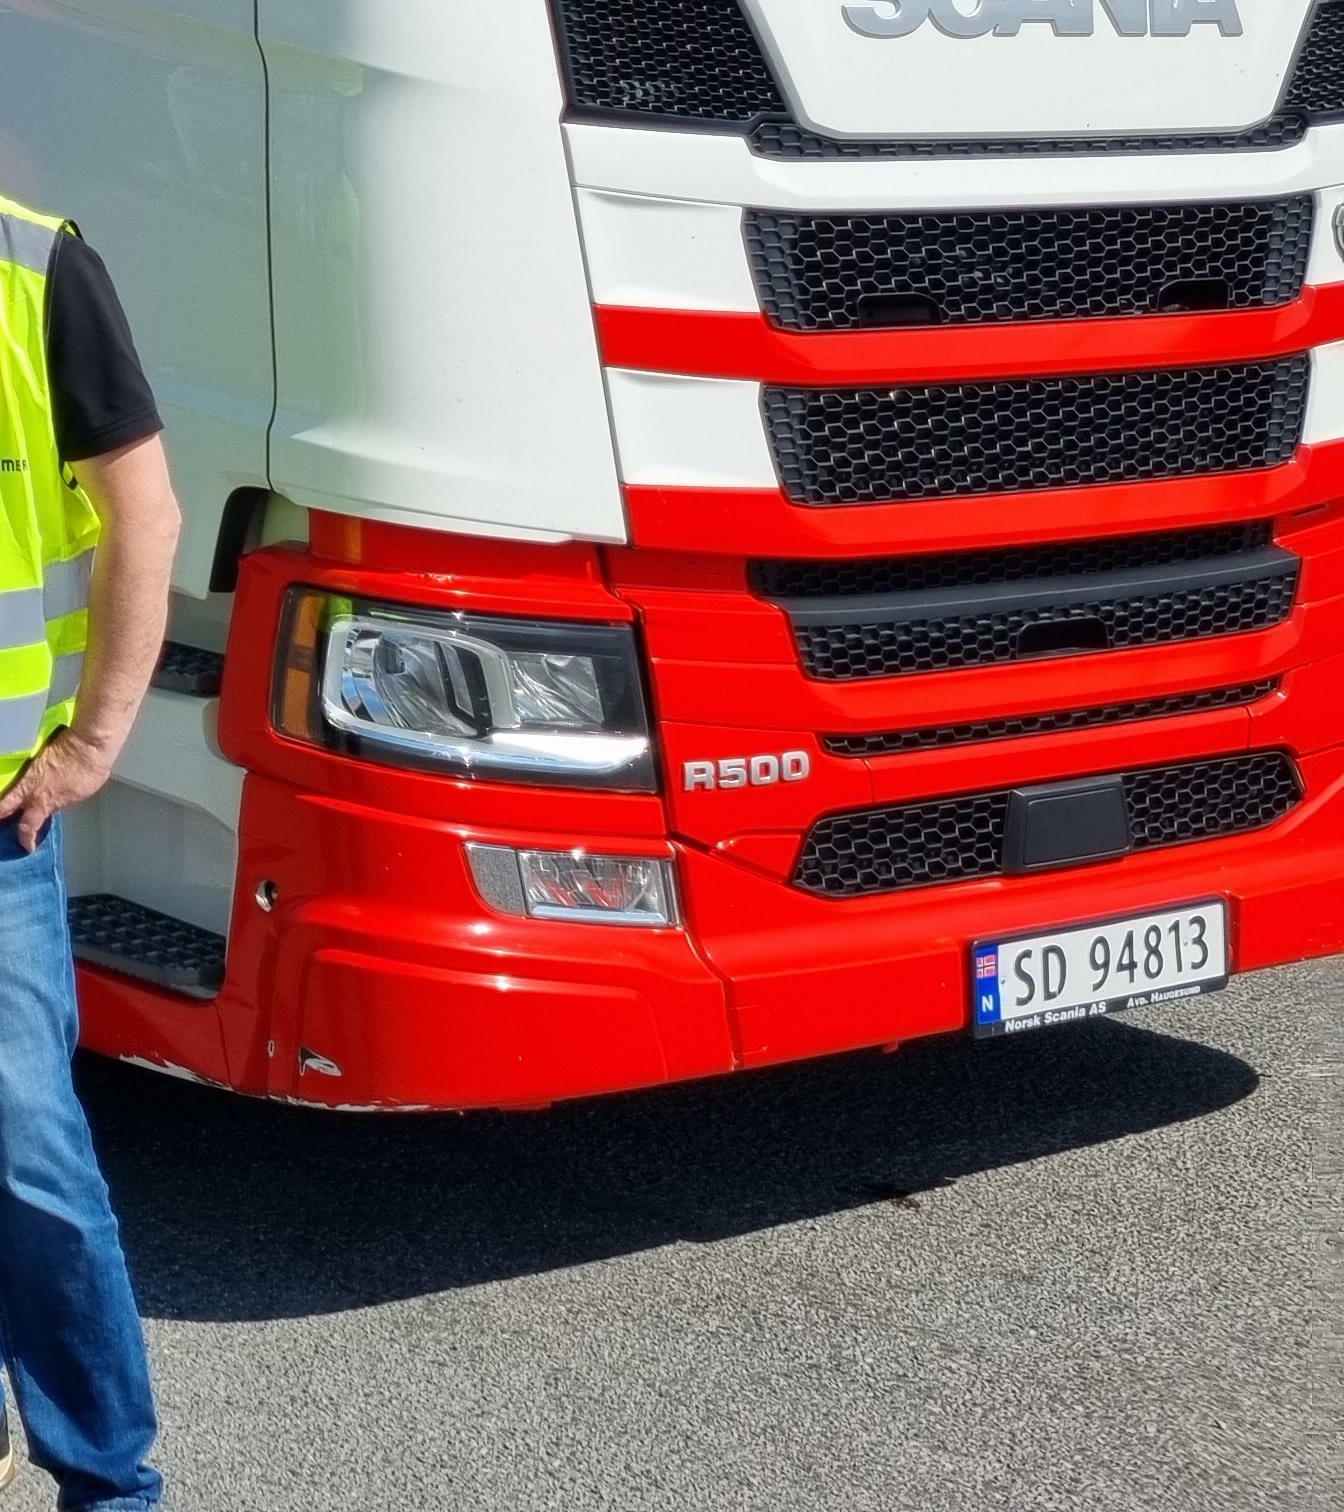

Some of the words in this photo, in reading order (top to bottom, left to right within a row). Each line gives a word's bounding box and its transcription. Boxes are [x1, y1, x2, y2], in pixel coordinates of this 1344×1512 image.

[681, 749, 811, 792] R500
[1014, 944, 1067, 1006] SD
[1088, 915, 1209, 992] 94813
[981, 995, 994, 1012] N
[1004, 1015, 1041, 1032] Norsk
[1044, 1006, 1086, 1024] Scania
[1089, 1001, 1107, 1016] AS
